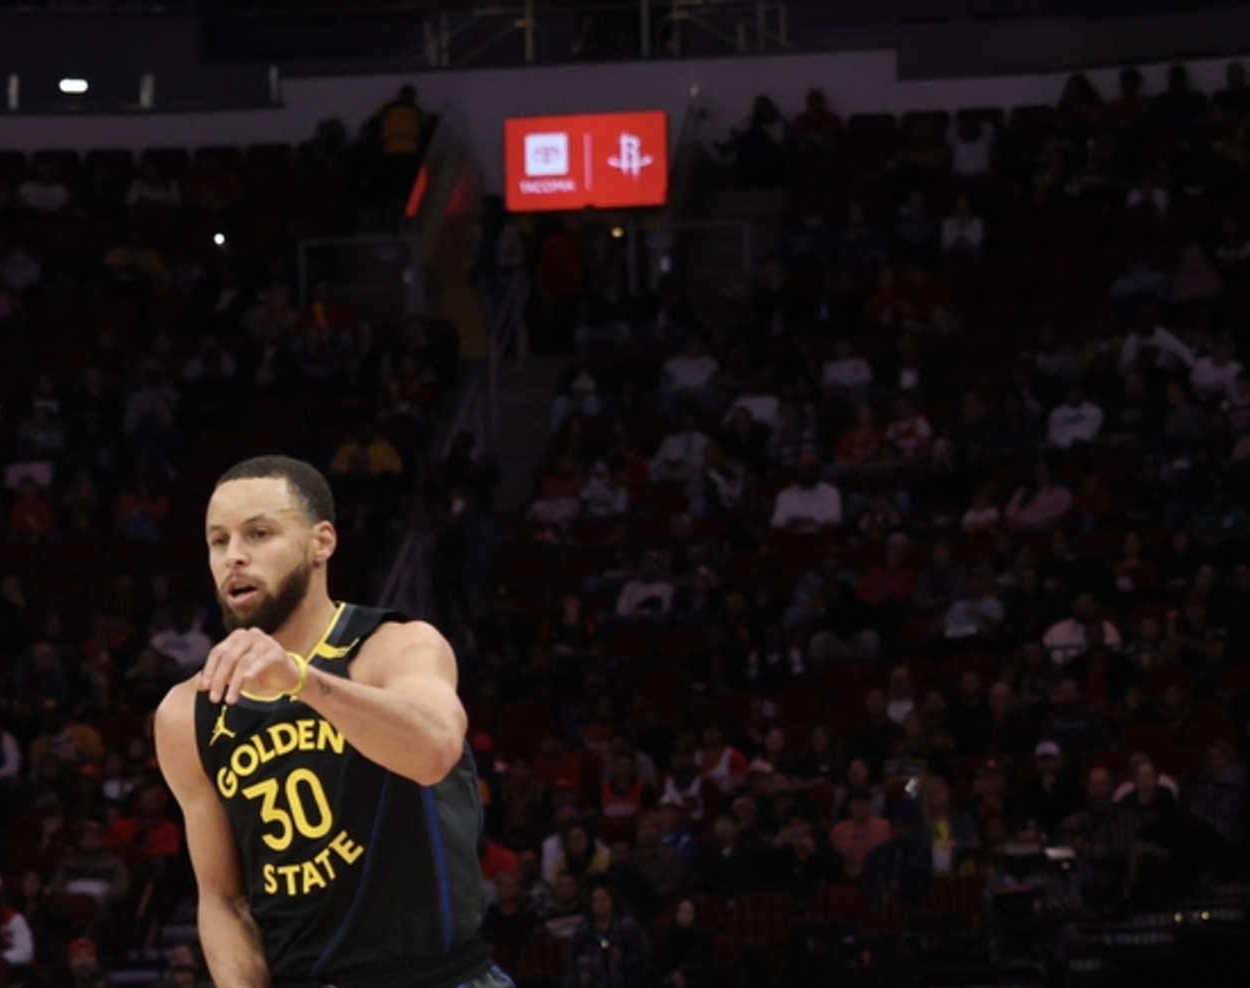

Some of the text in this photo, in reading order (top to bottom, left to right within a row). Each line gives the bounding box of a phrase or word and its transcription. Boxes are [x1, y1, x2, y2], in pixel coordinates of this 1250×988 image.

[217, 719, 346, 798] GOLDEN
[242, 768, 332, 851] 30
[263, 830, 365, 895] STATE
